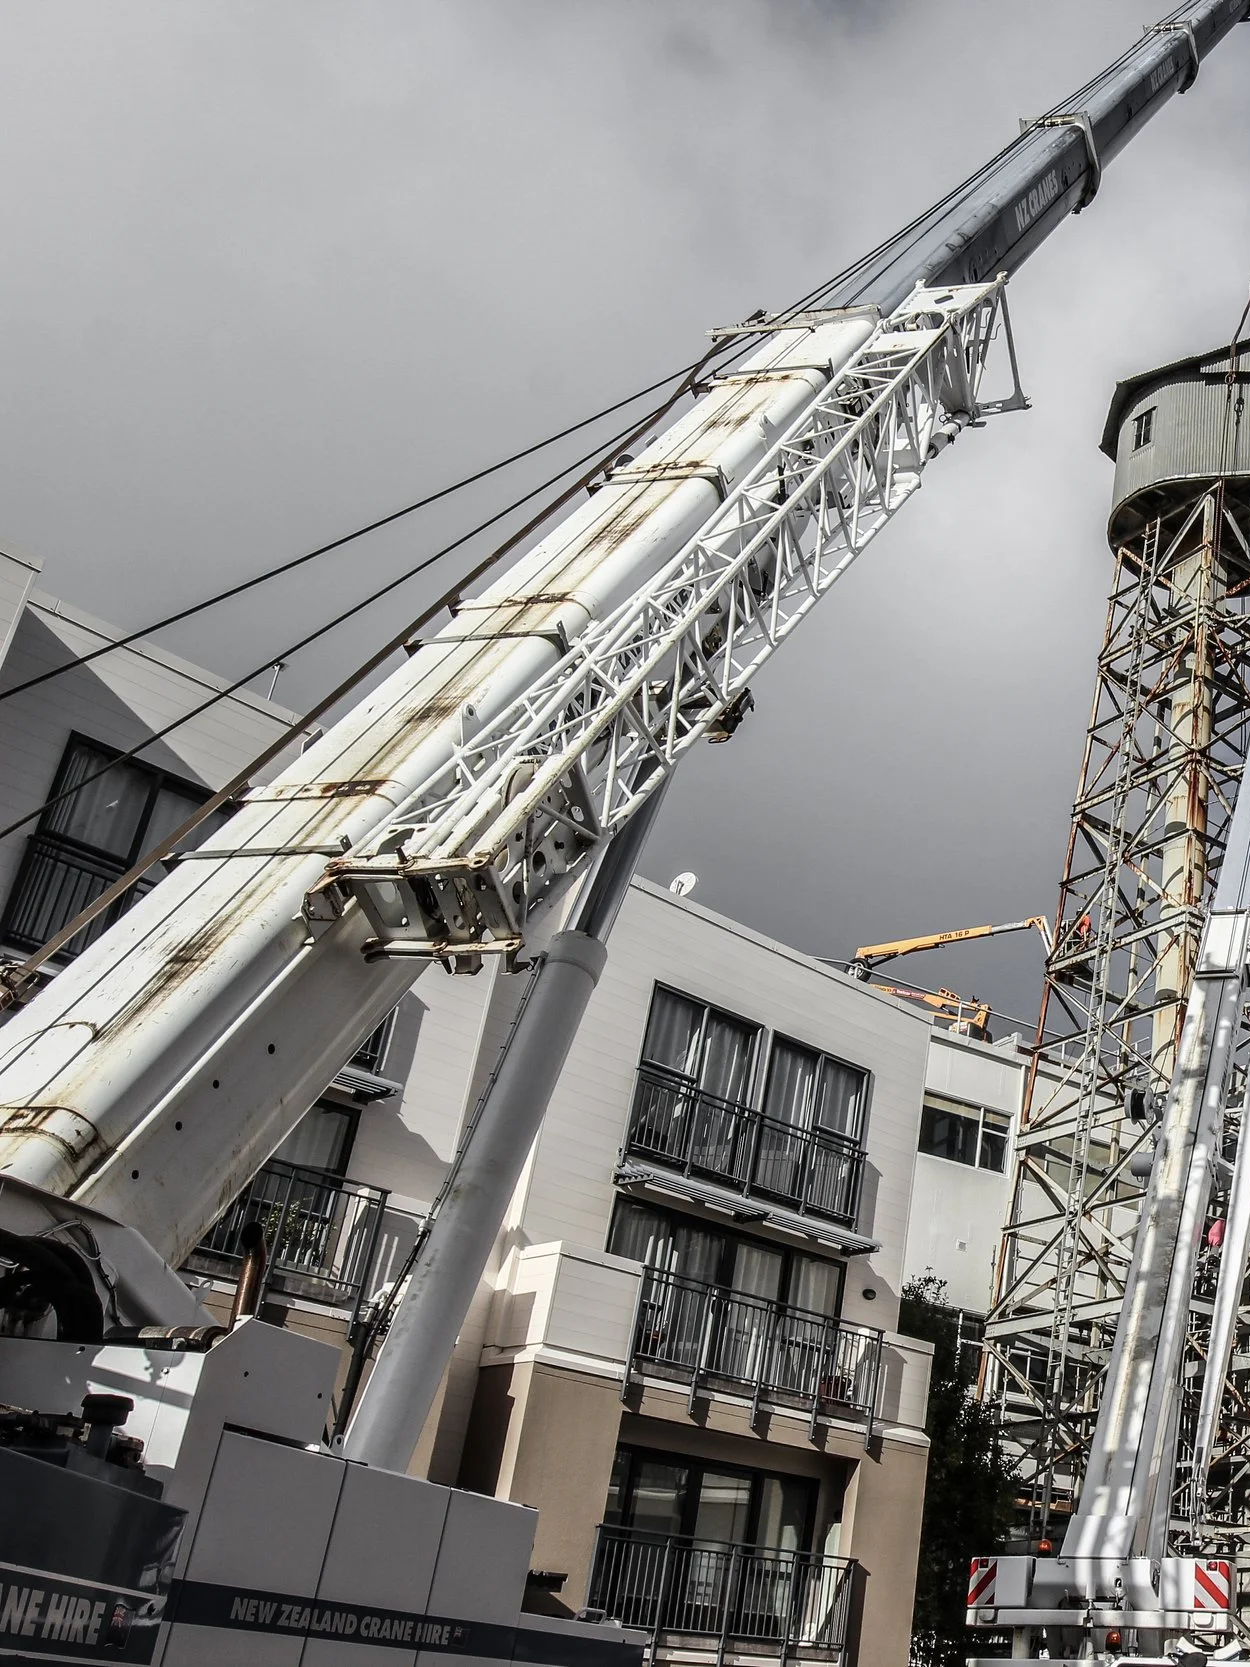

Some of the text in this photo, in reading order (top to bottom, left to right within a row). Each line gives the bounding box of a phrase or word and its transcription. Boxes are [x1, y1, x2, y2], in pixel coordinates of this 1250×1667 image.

[1015, 170, 1058, 231] NZ CRANES
[0, 1583, 107, 1645] NE HIRE
[230, 1597, 450, 1646] NEW ZEALAND CRANE HIRE
